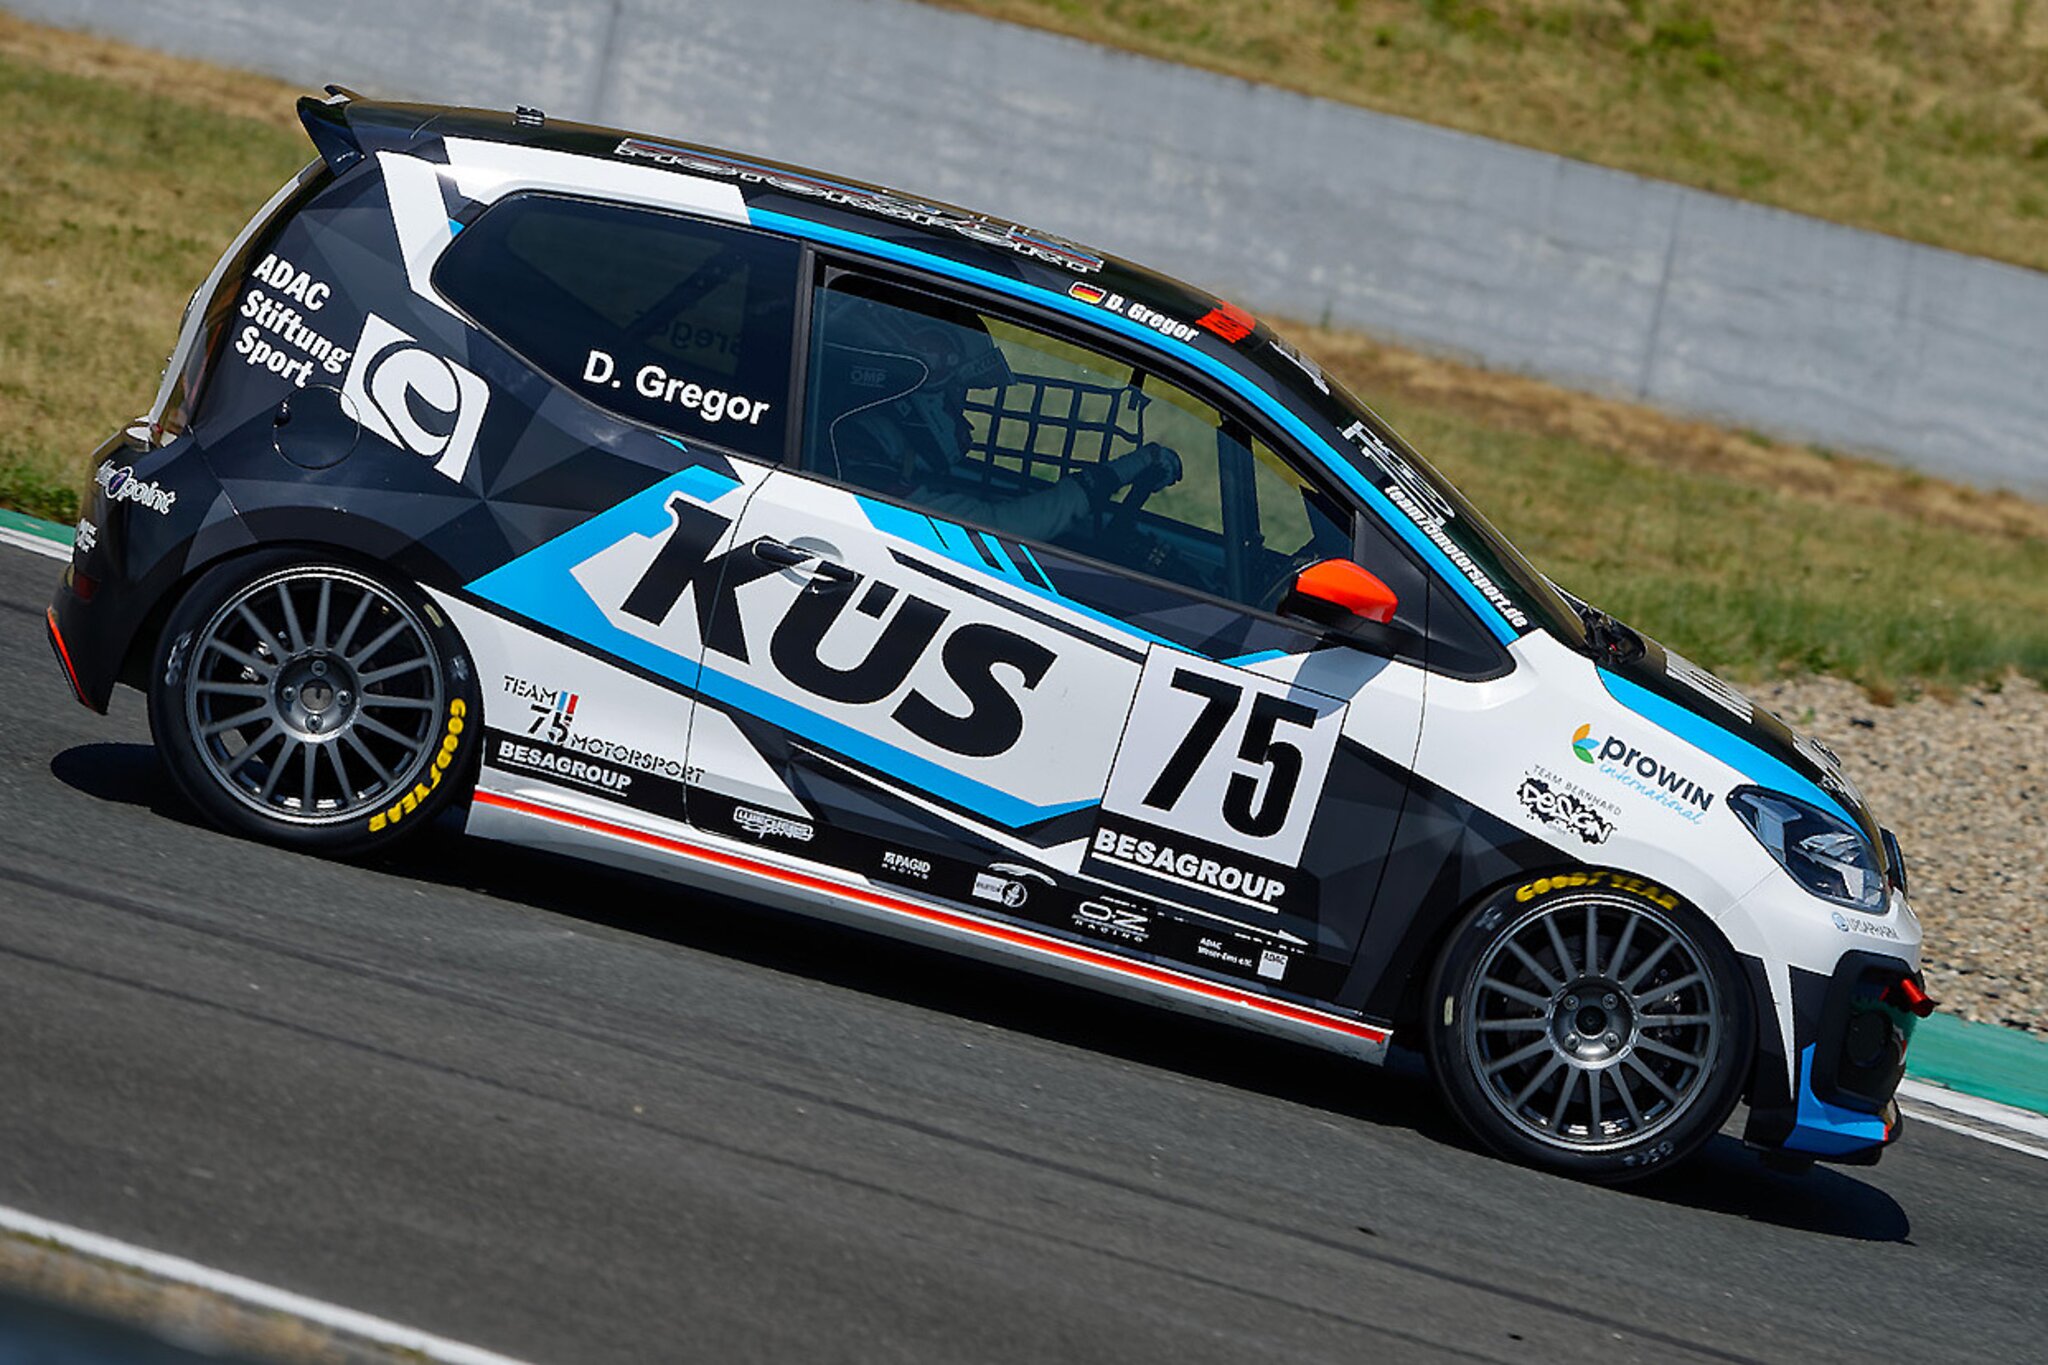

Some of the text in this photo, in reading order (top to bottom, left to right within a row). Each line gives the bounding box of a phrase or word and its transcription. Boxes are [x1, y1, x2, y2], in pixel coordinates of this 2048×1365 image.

[252, 253, 331, 311] ADAC
[240, 290, 352, 375] Stiftung
[1104, 294, 1199, 343] D. Gregor
[235, 325, 316, 388] Sport
[583, 350, 769, 425] D. Gregor
[620, 497, 1058, 758] KÜS
[503, 675, 558, 705] TEAM
[528, 703, 574, 748] 75
[1141, 666, 1319, 838] 75
[499, 740, 632, 790] BESAGROUP
[571, 733, 705, 784] MOTORSPORT
[1533, 765, 1622, 816] TEAM BERNHARD
[1599, 762, 1706, 825] international
[895, 855, 931, 873] PAGID
[1093, 827, 1286, 902] BESAGROUP
